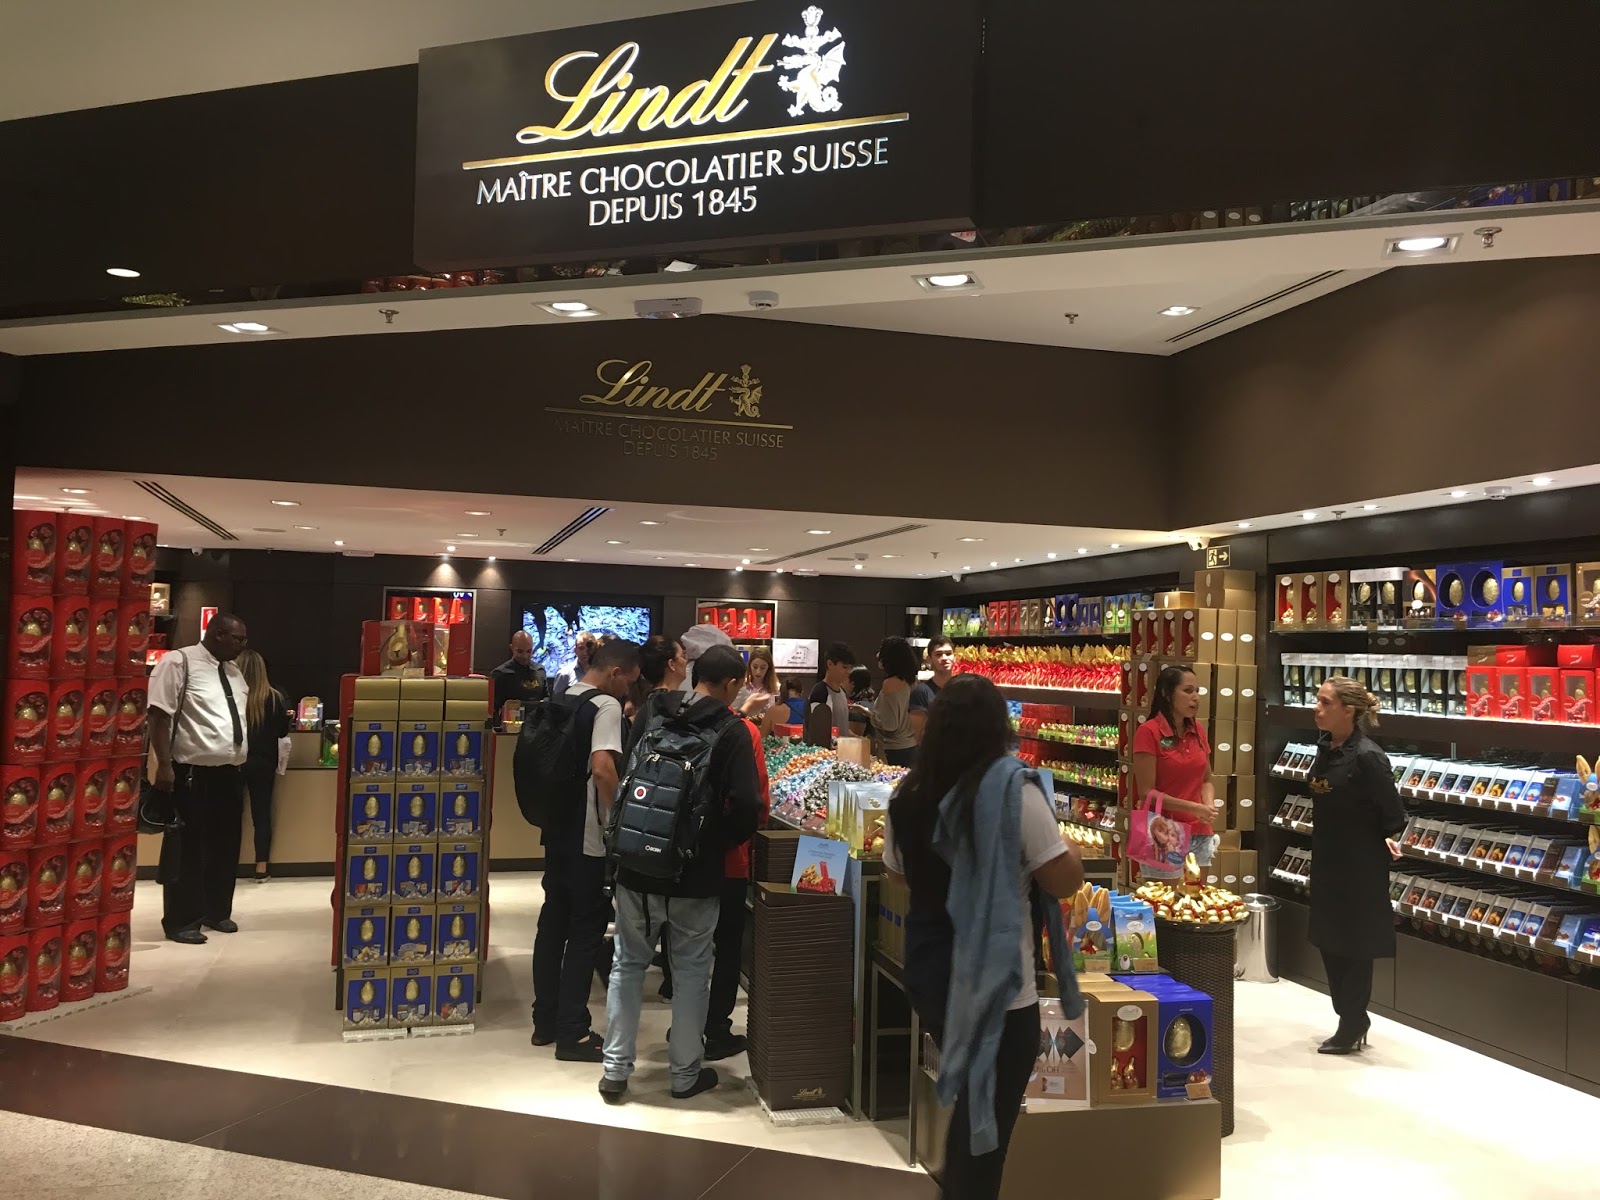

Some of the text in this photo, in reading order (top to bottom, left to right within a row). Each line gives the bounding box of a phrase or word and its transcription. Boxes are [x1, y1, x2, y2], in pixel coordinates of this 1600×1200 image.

[515, 32, 779, 145] Lindt
[476, 136, 889, 205] MAÎTRE CHOCOLATIER SUISSE
[588, 185, 758, 227] DEPUIS 1845
[578, 359, 728, 412] Lindt
[618, 423, 732, 445] CHOCOLATIER
[735, 431, 784, 449] SUISSE
[623, 440, 718, 460] DEPUIS 1845
